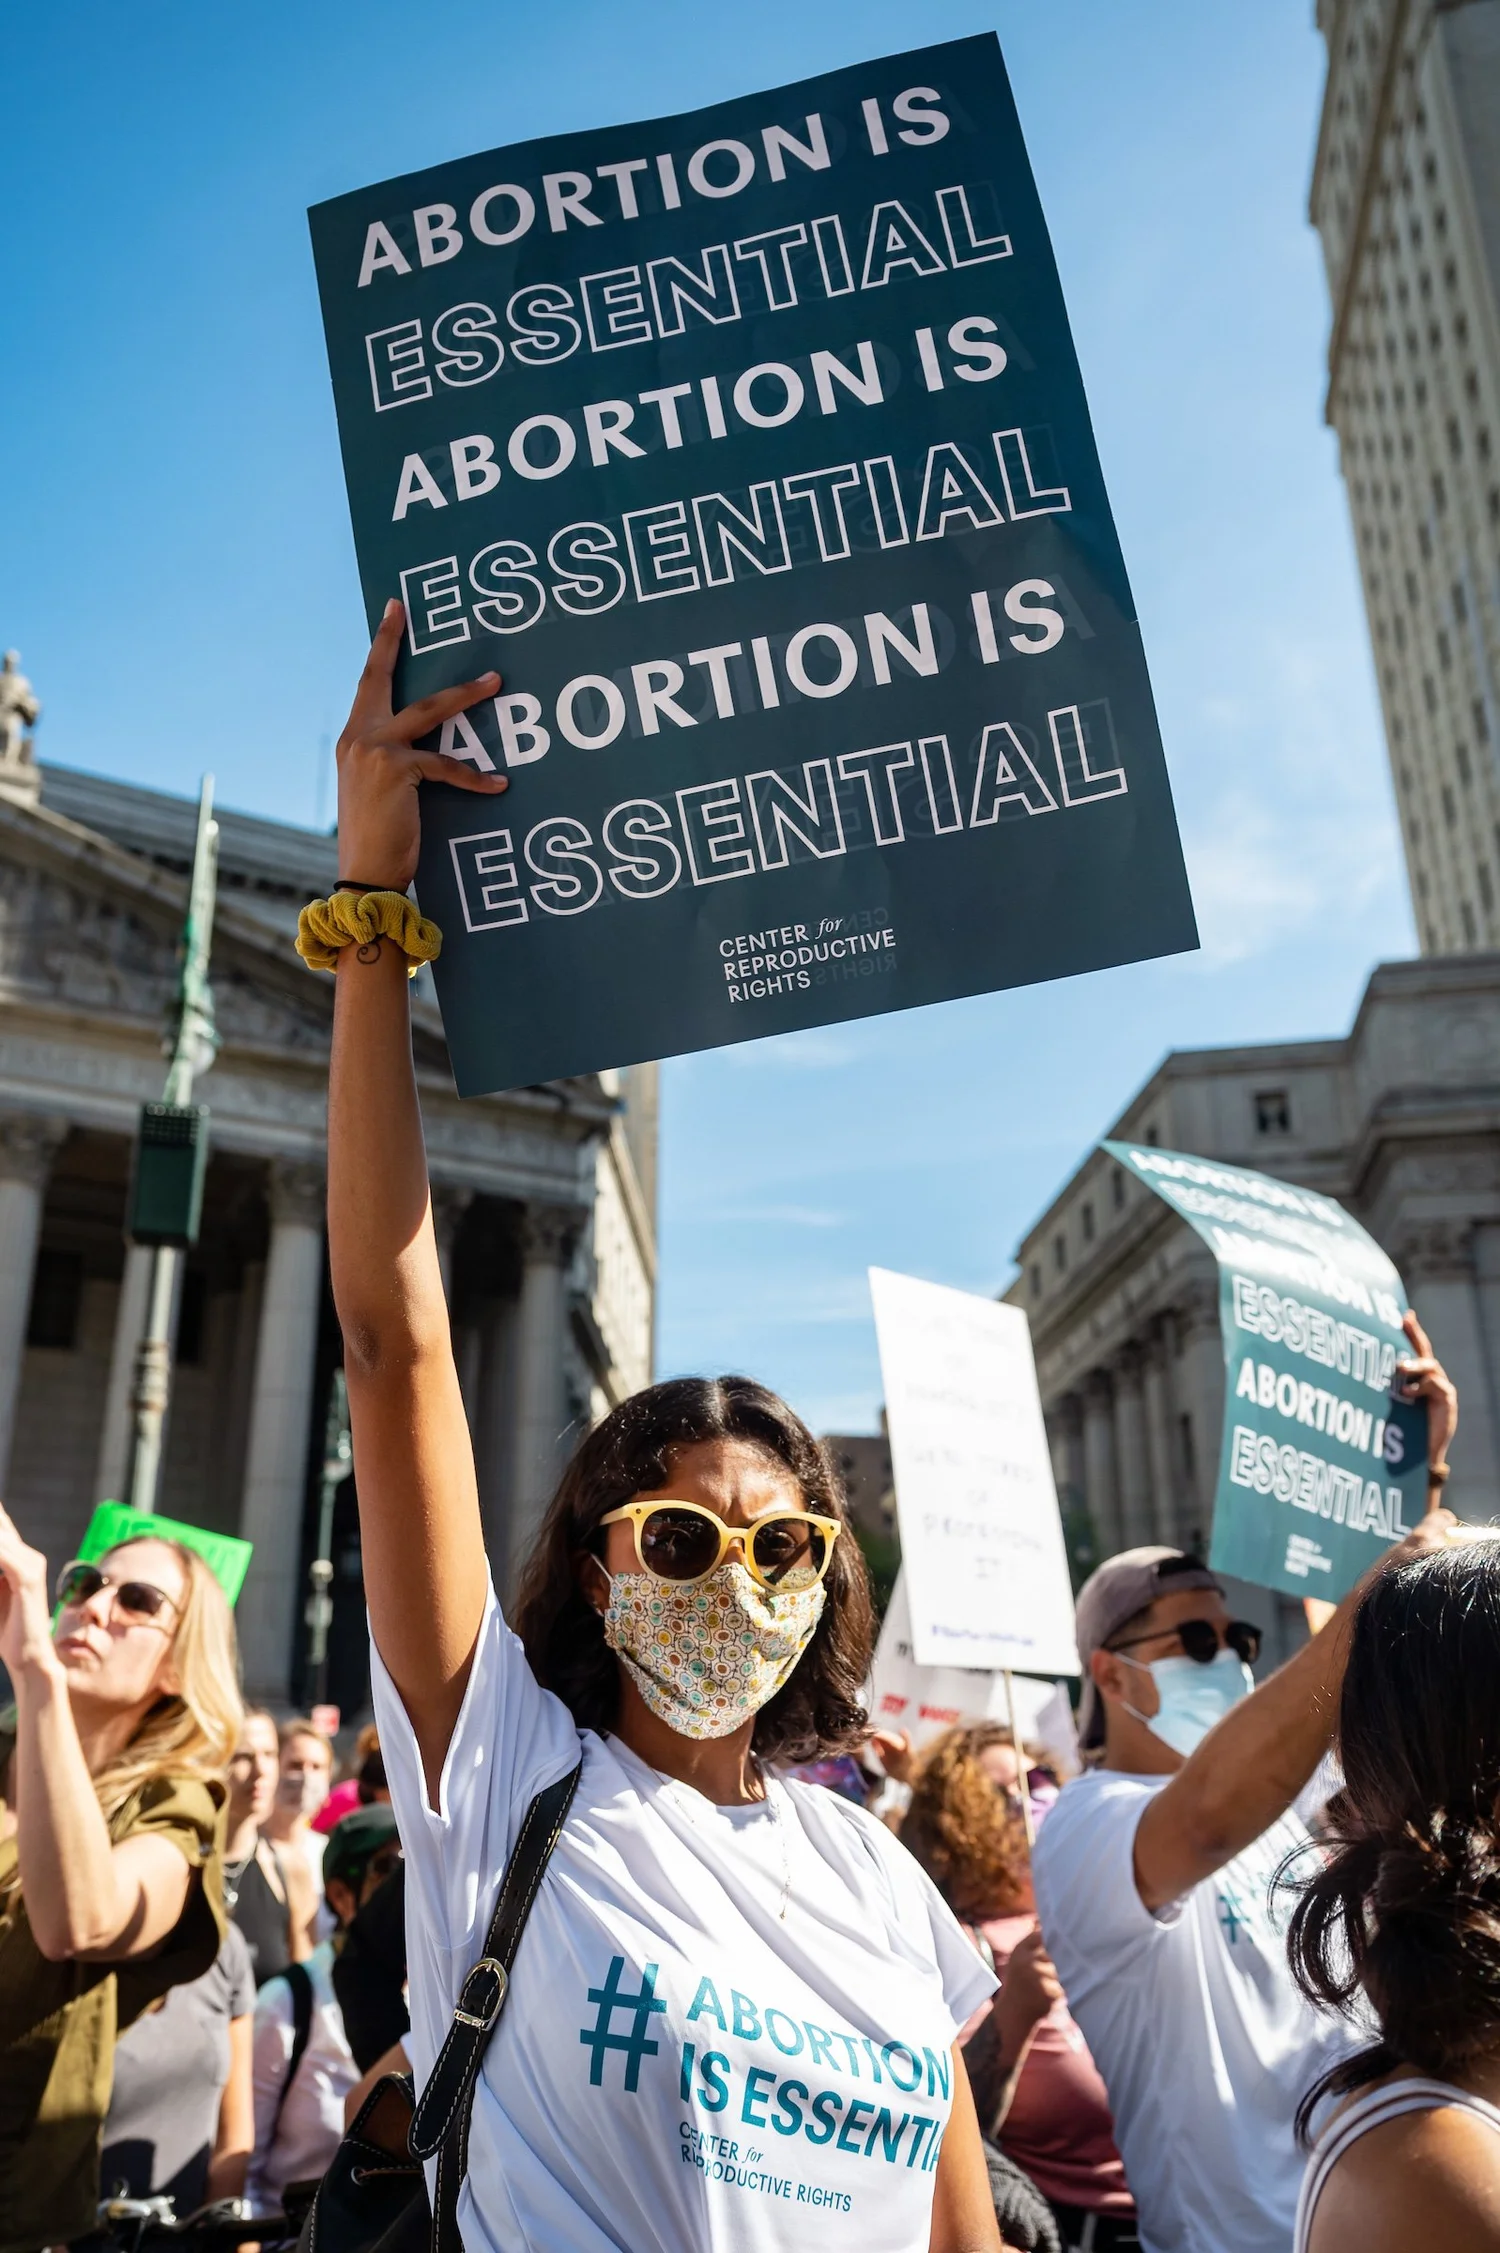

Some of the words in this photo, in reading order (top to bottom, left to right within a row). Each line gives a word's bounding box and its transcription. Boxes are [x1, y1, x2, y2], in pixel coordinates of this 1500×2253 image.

[357, 113, 831, 288] ABORTION
[861, 87, 950, 156] IS
[365, 185, 1014, 413] ESSENTIAL
[391, 340, 885, 522] ABORTION
[915, 316, 1008, 393] IS
[399, 427, 1073, 656] ESSENTIAL
[438, 602, 940, 773] ABORTION
[970, 578, 1065, 665] IS
[448, 704, 1129, 933] ESSENTIAL
[719, 924, 810, 958] CENTER
[815, 917, 844, 940] for
[723, 928, 896, 981] REPRODUCTIVE
[727, 970, 811, 1003] RIGHTS
[1236, 1357, 1373, 1453] ABORTION
[1372, 1418, 1405, 1464] IS
[1229, 1424, 1413, 1542] ESSENTIAL
[680, 2042, 731, 2113] IS
[686, 1976, 949, 2101] ABORTION
[679, 2121, 738, 2161] CENTER
[741, 2146, 764, 2164] for
[681, 2144, 792, 2199] RPRODUCTIVE
[796, 2183, 852, 2212] RIGHTS
